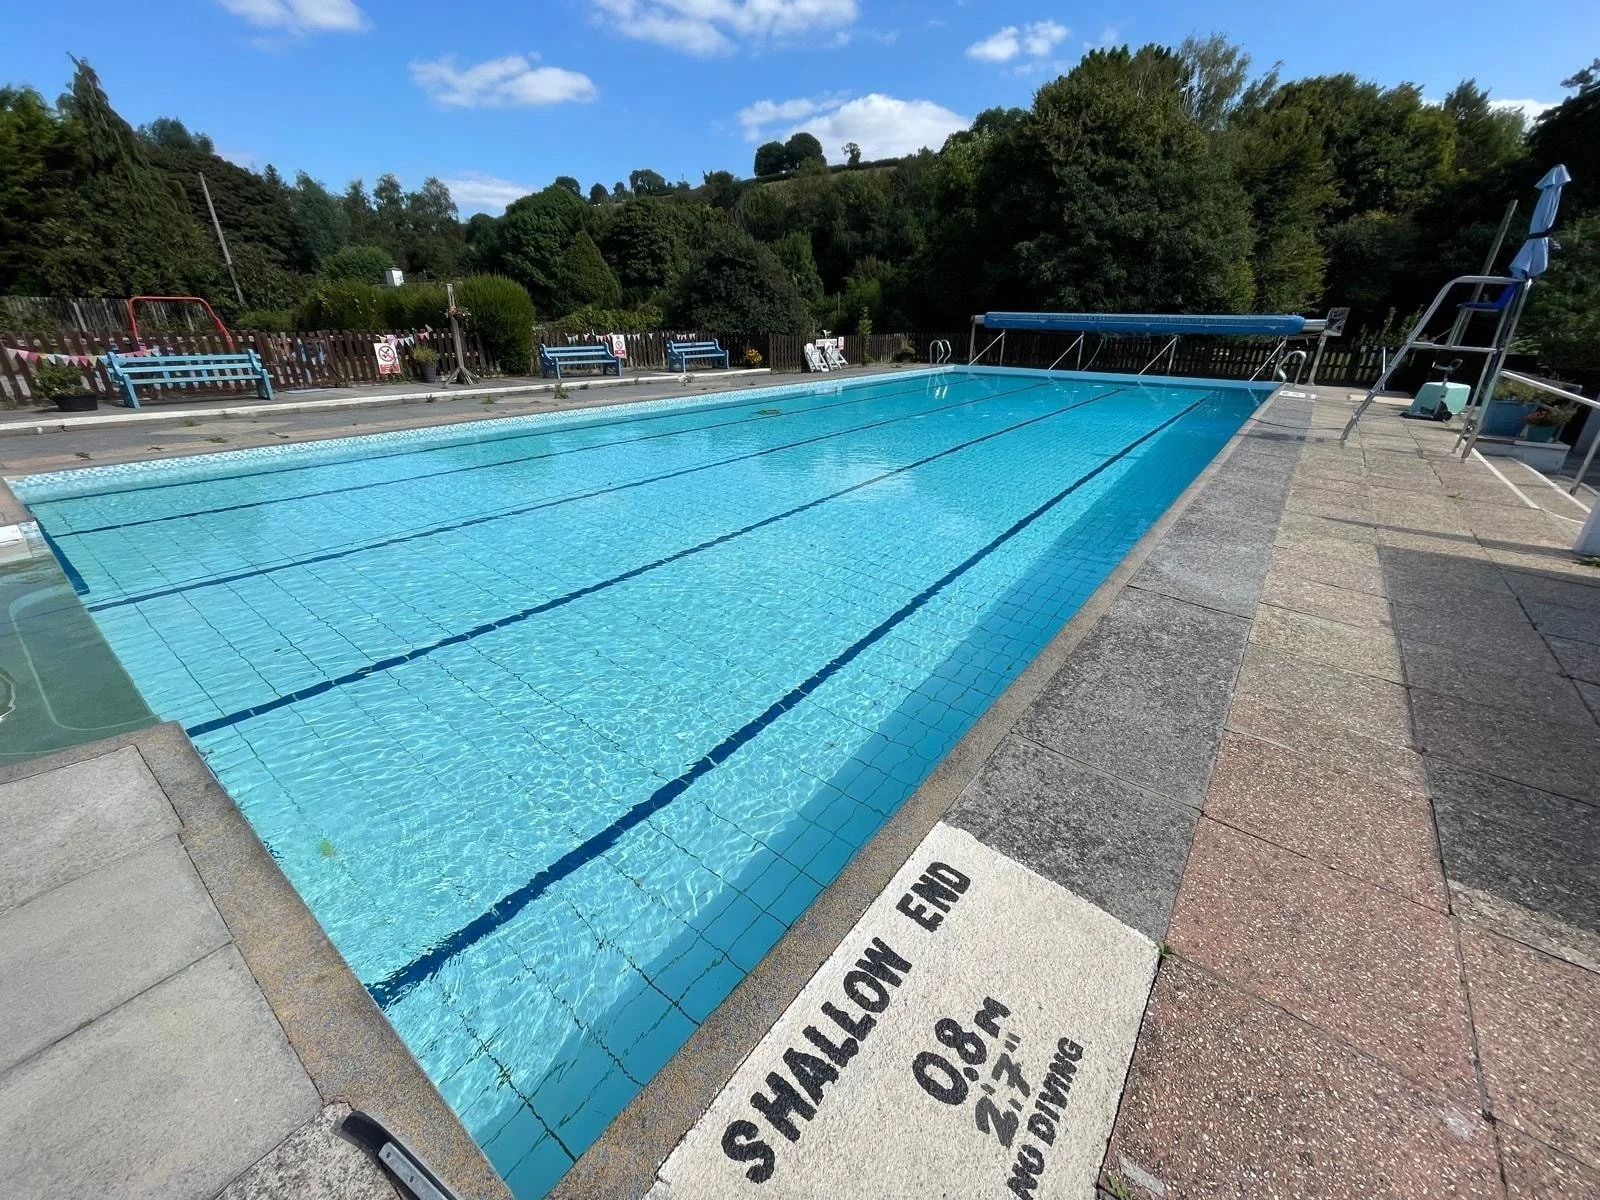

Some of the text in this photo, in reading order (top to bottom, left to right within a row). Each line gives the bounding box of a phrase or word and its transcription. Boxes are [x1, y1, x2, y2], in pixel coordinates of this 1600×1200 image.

[721, 861, 971, 1184] SHALLOW END
[1007, 1037, 1084, 1200] NO DIVING
